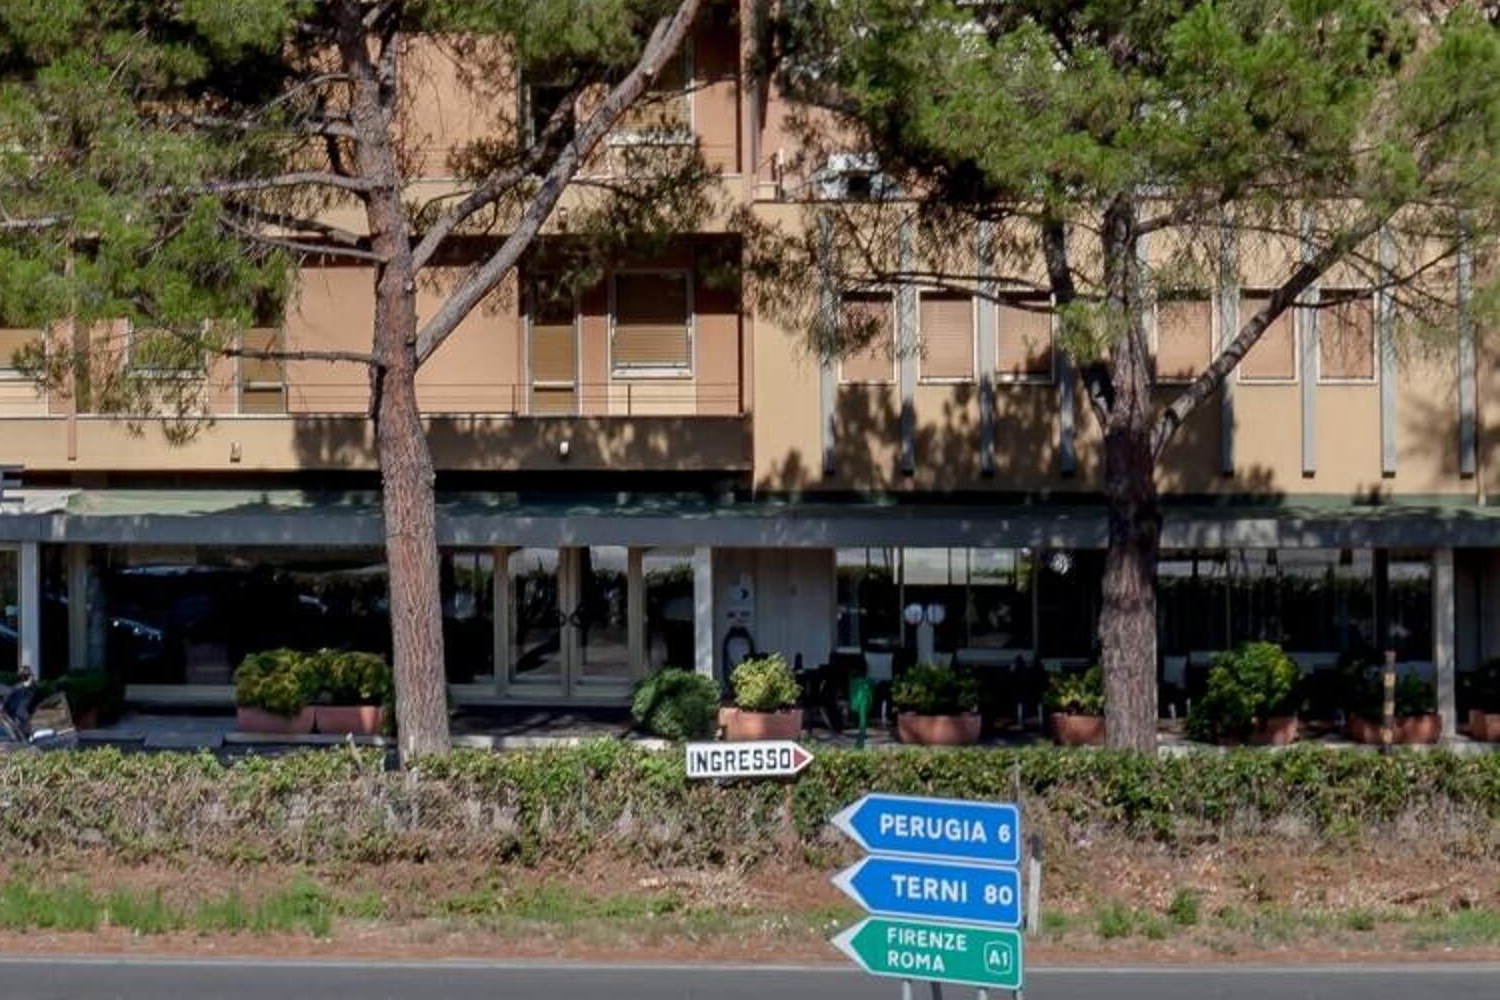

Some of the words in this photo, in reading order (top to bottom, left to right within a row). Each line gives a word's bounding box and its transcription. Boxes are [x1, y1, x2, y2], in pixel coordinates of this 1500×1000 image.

[689, 747, 791, 773] INGRESSO
[880, 813, 987, 843] PERUGIA
[999, 824, 1011, 843] 6
[892, 873, 968, 903] TERNI
[985, 884, 1013, 905] 80
[887, 927, 967, 952] FIRENZE
[888, 951, 945, 973] ROMA
[989, 945, 1008, 966] A1
